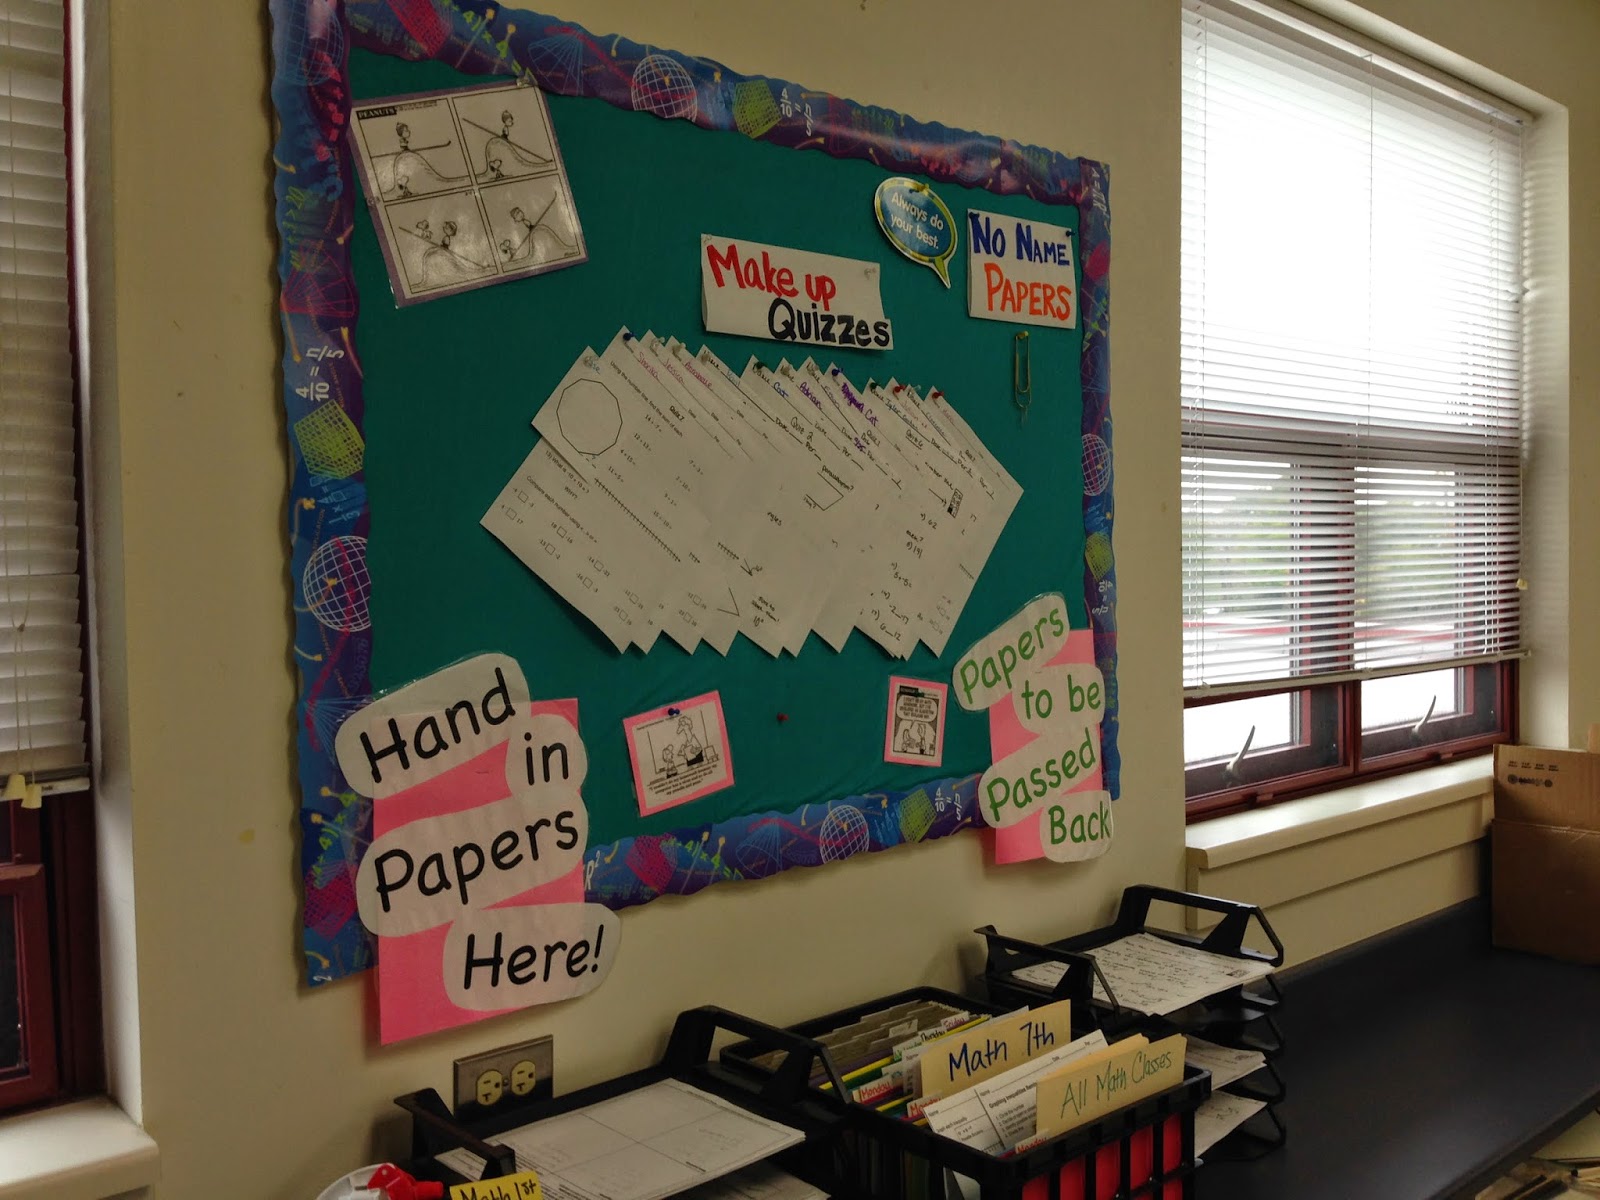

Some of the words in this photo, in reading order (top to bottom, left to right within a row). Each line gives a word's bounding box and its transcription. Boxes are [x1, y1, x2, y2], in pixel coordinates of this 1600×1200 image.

[358, 107, 395, 118] PEANUTS
[890, 214, 914, 238] your
[916, 226, 940, 249] best.
[891, 191, 928, 220] Always
[930, 212, 944, 230] do
[707, 244, 799, 298] Make
[806, 275, 836, 311] up
[768, 298, 890, 347] Quizzes
[864, 409, 878, 427] Cat
[960, 608, 1064, 704] Papers
[1022, 680, 1052, 719] to
[1068, 675, 1100, 712] be
[360, 668, 516, 783] Hand
[524, 732, 569, 785] in
[987, 727, 1096, 821] Passed
[1049, 802, 1110, 844] Back
[374, 810, 578, 912] Papers
[464, 924, 604, 990] Here!
[949, 1037, 1007, 1081] Math
[1020, 1021, 1055, 1056] 7th
[861, 1079, 891, 1098] Monday
[1061, 1080, 1087, 1118] All
[1096, 1060, 1127, 1101] Math
[1131, 1050, 1172, 1085] Classes
[515, 1178, 536, 1200] 1st
